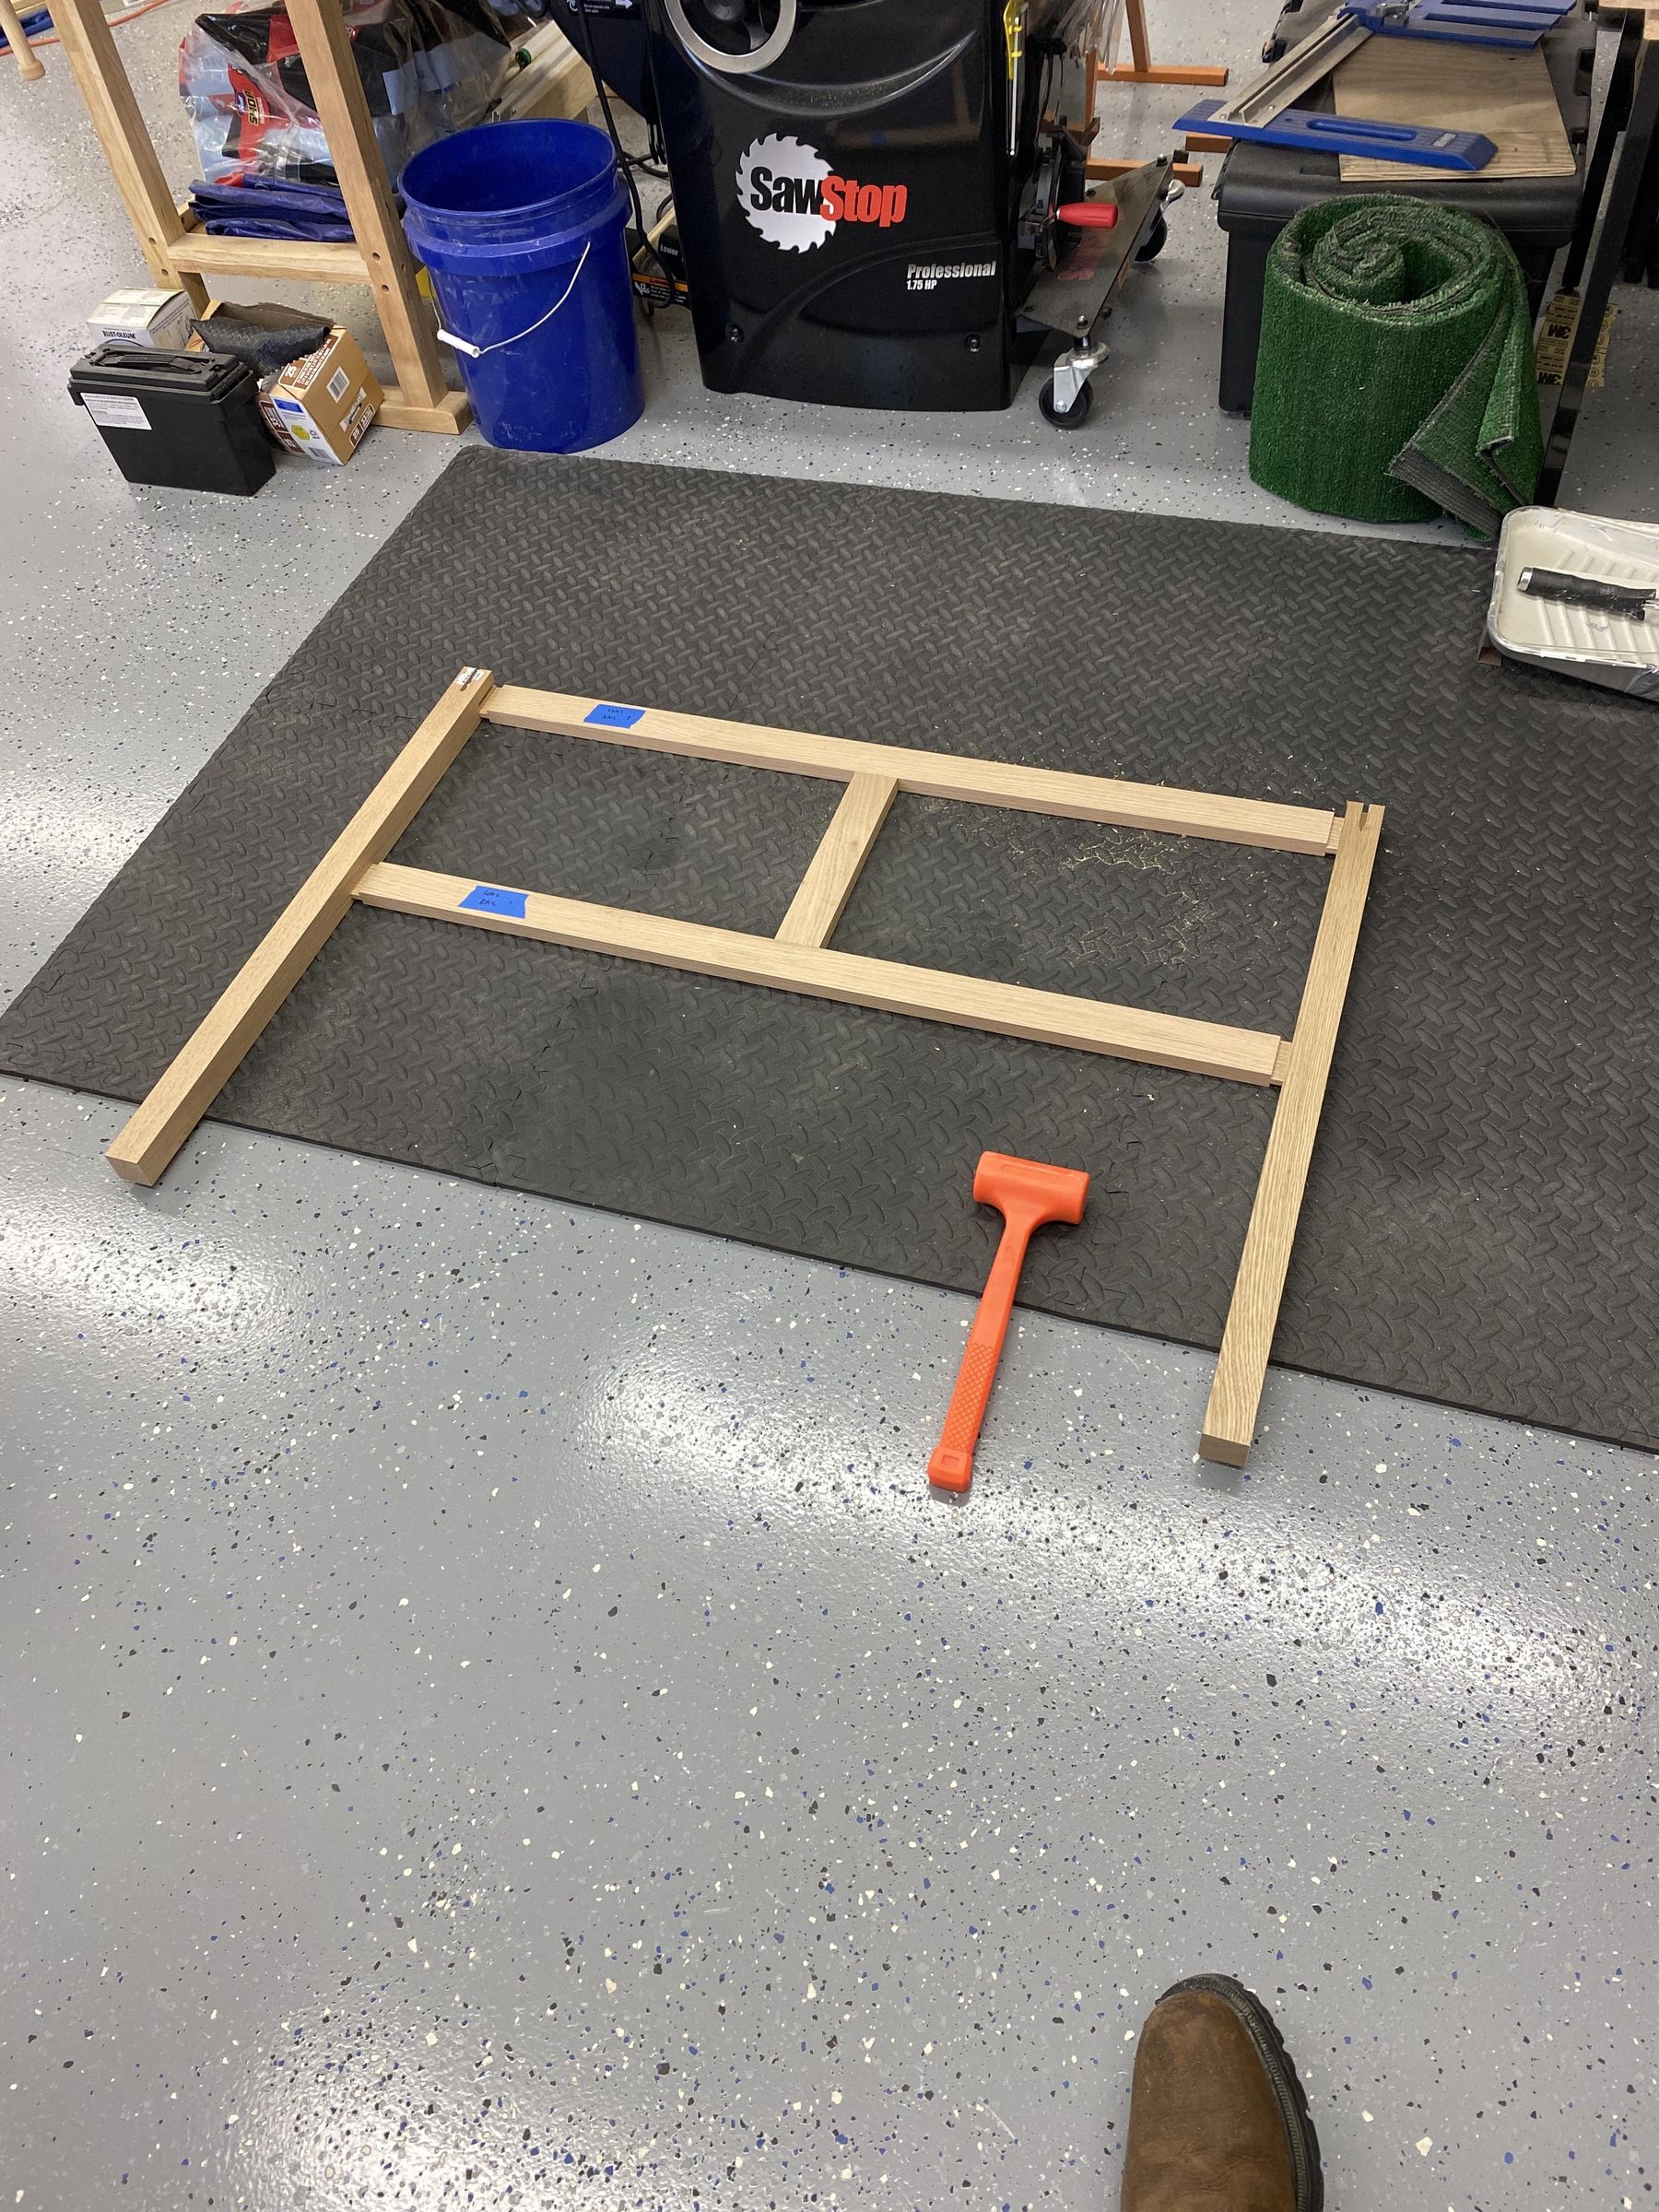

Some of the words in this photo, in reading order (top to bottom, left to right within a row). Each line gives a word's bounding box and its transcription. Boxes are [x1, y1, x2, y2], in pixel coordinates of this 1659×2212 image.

[750, 166, 908, 228] SawStop
[660, 244, 678, 256] Lower
[907, 261, 996, 278] Professional
[906, 279, 923, 290] 1.75
[924, 279, 937, 290] HP
[1547, 324, 1571, 339] 3M
[285, 365, 297, 378] 25
[1537, 371, 1562, 385] 3M
